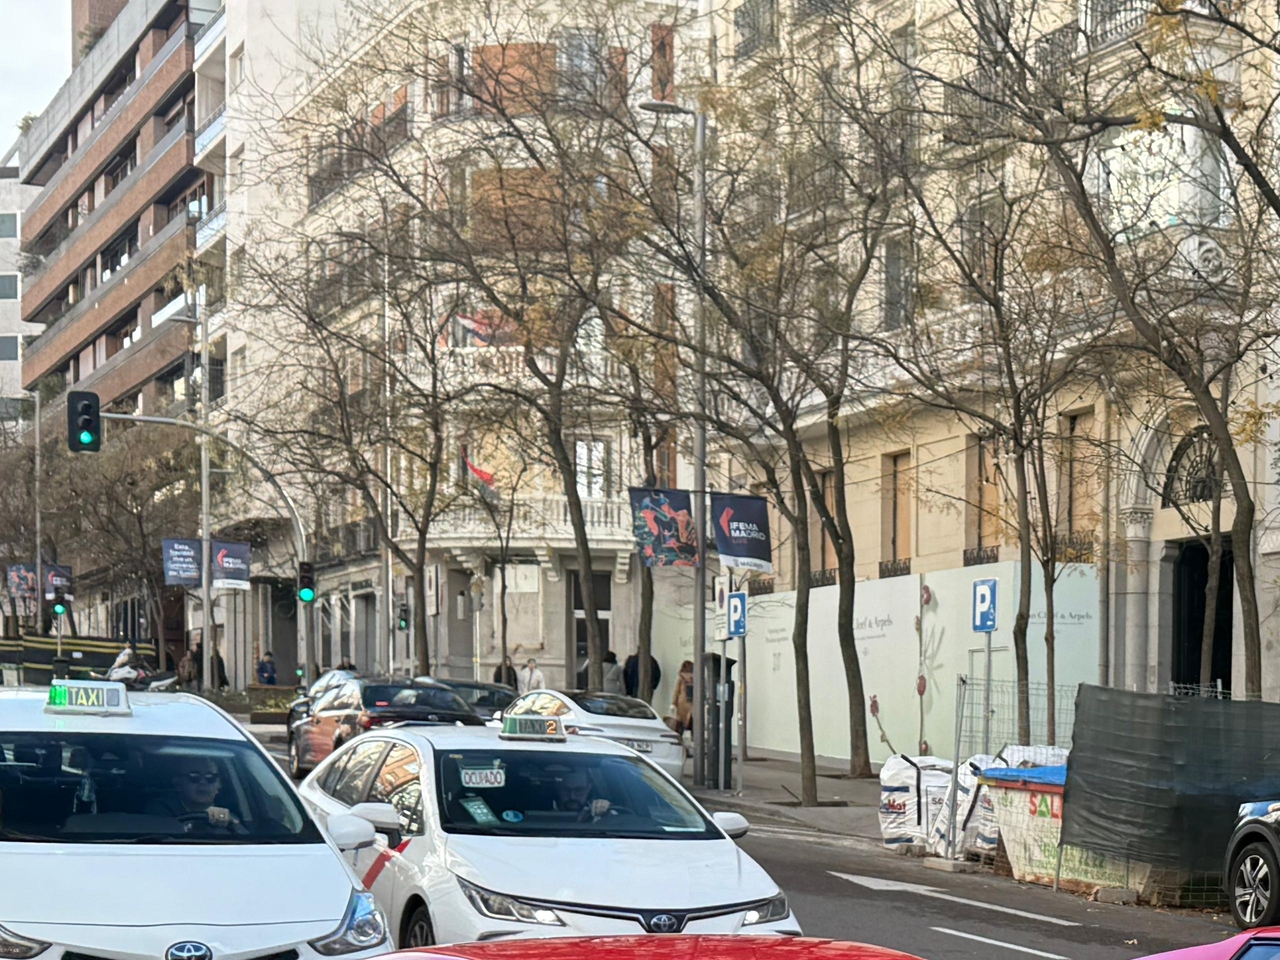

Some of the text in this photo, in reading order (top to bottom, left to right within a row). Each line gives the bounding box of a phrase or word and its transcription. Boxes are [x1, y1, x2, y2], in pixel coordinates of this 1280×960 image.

[729, 521, 759, 532] IFEMA
[731, 530, 765, 541] MADRID
[975, 584, 991, 626] P
[730, 597, 742, 633] P
[1069, 611, 1093, 622] Arpels
[69, 687, 105, 706] TAXI
[519, 718, 557, 735] TAXI 2
[463, 770, 502, 786] OCUPADO
